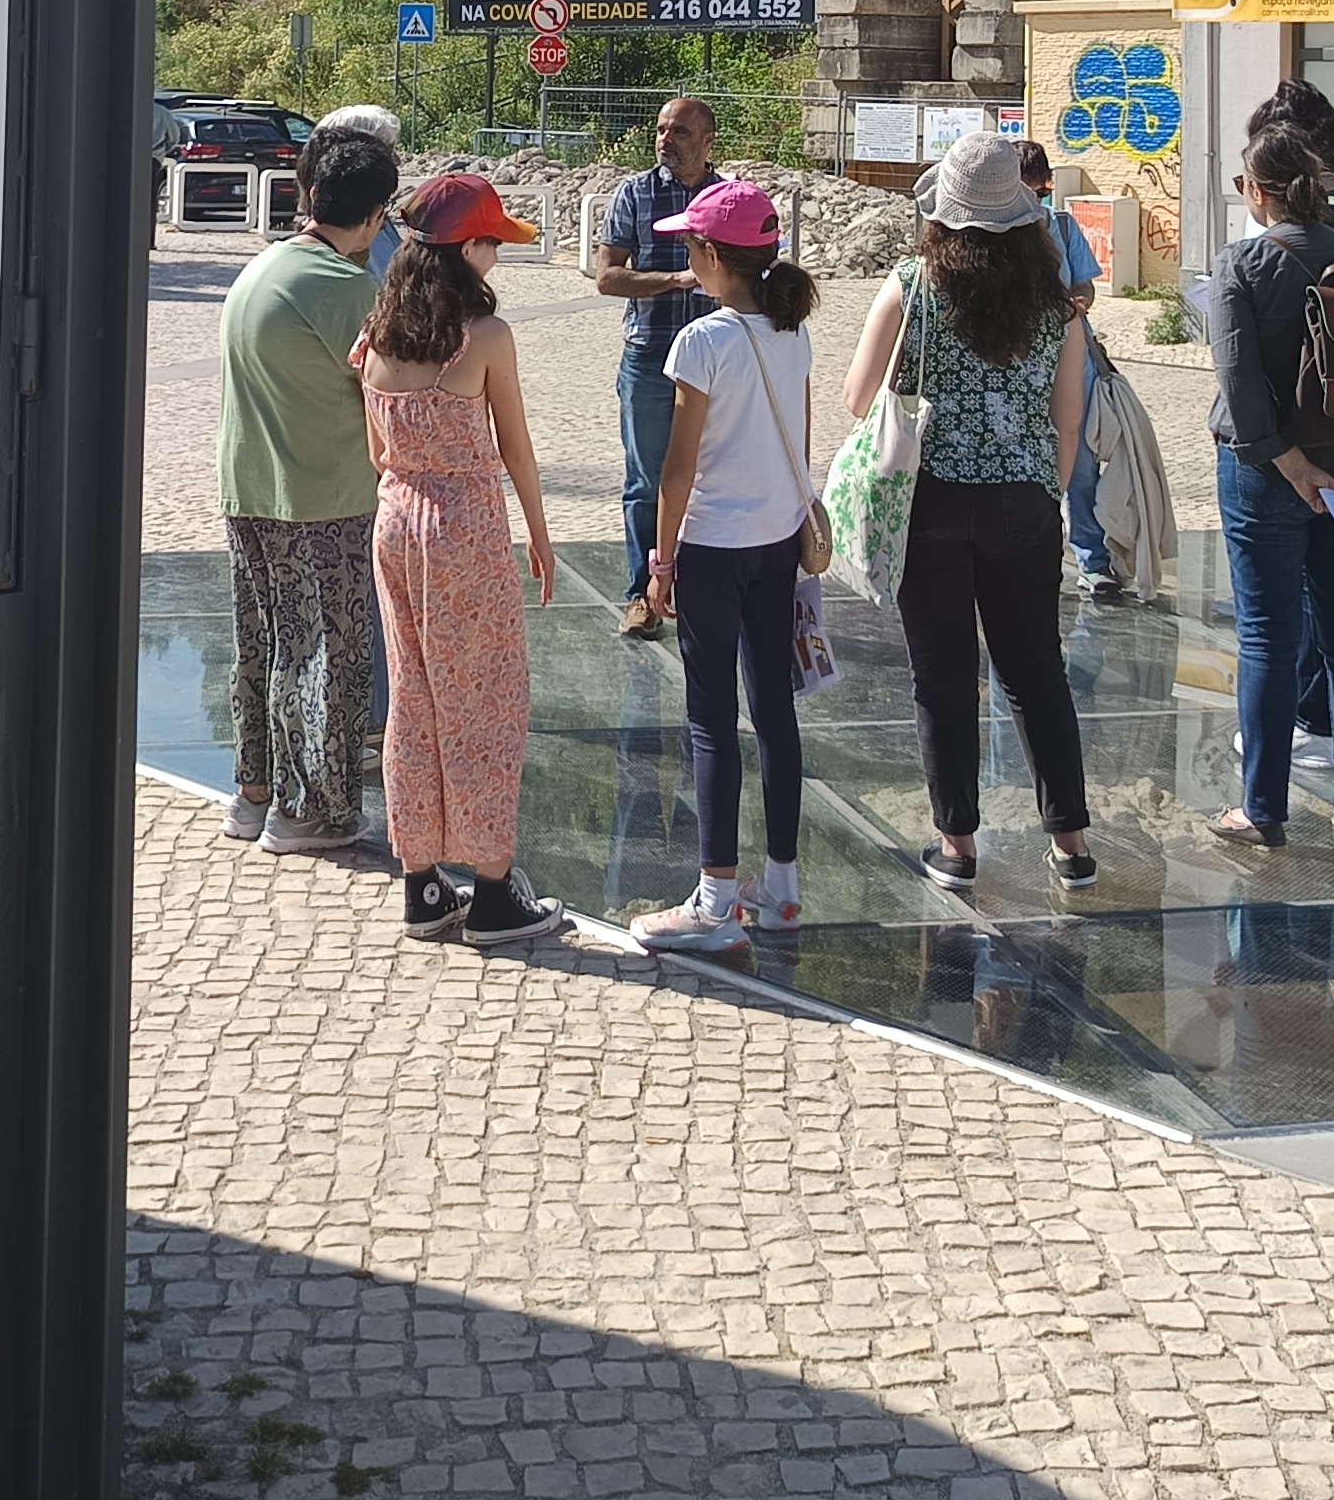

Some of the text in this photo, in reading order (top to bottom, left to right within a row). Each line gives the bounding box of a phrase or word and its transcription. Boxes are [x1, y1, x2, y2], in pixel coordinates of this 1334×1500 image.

[461, 4, 485, 21] NA
[570, 2, 648, 19] PIEDADE
[660, 0, 701, 19] 216
[708, 0, 750, 18] 044
[531, 48, 566, 62] STOP
